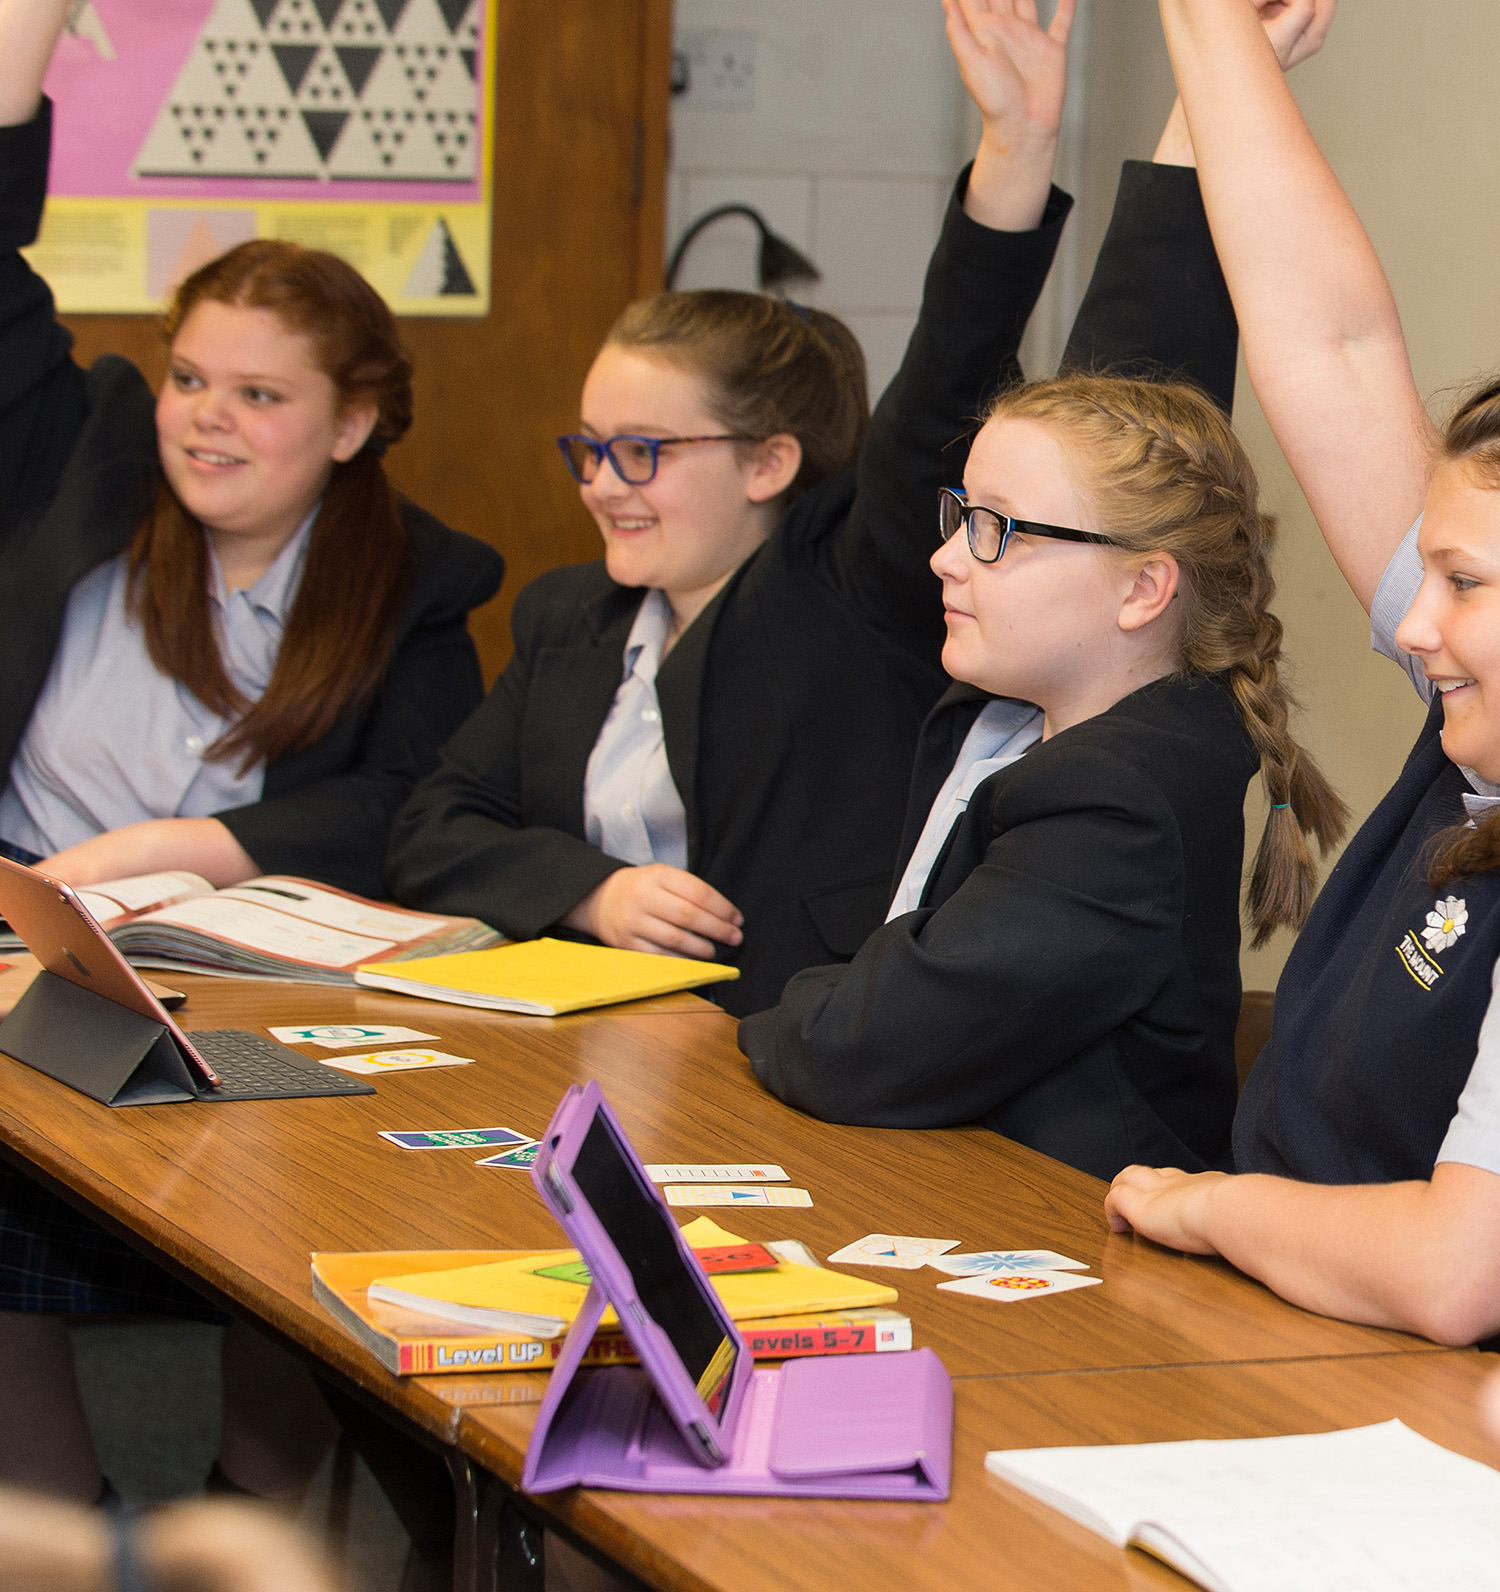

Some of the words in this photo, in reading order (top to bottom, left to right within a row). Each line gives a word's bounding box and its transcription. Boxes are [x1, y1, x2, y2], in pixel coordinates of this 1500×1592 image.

[749, 1332, 814, 1352] evels
[822, 1329, 866, 1350] 5-7
[437, 1344, 504, 1366] Level
[509, 1342, 545, 1363] UP
